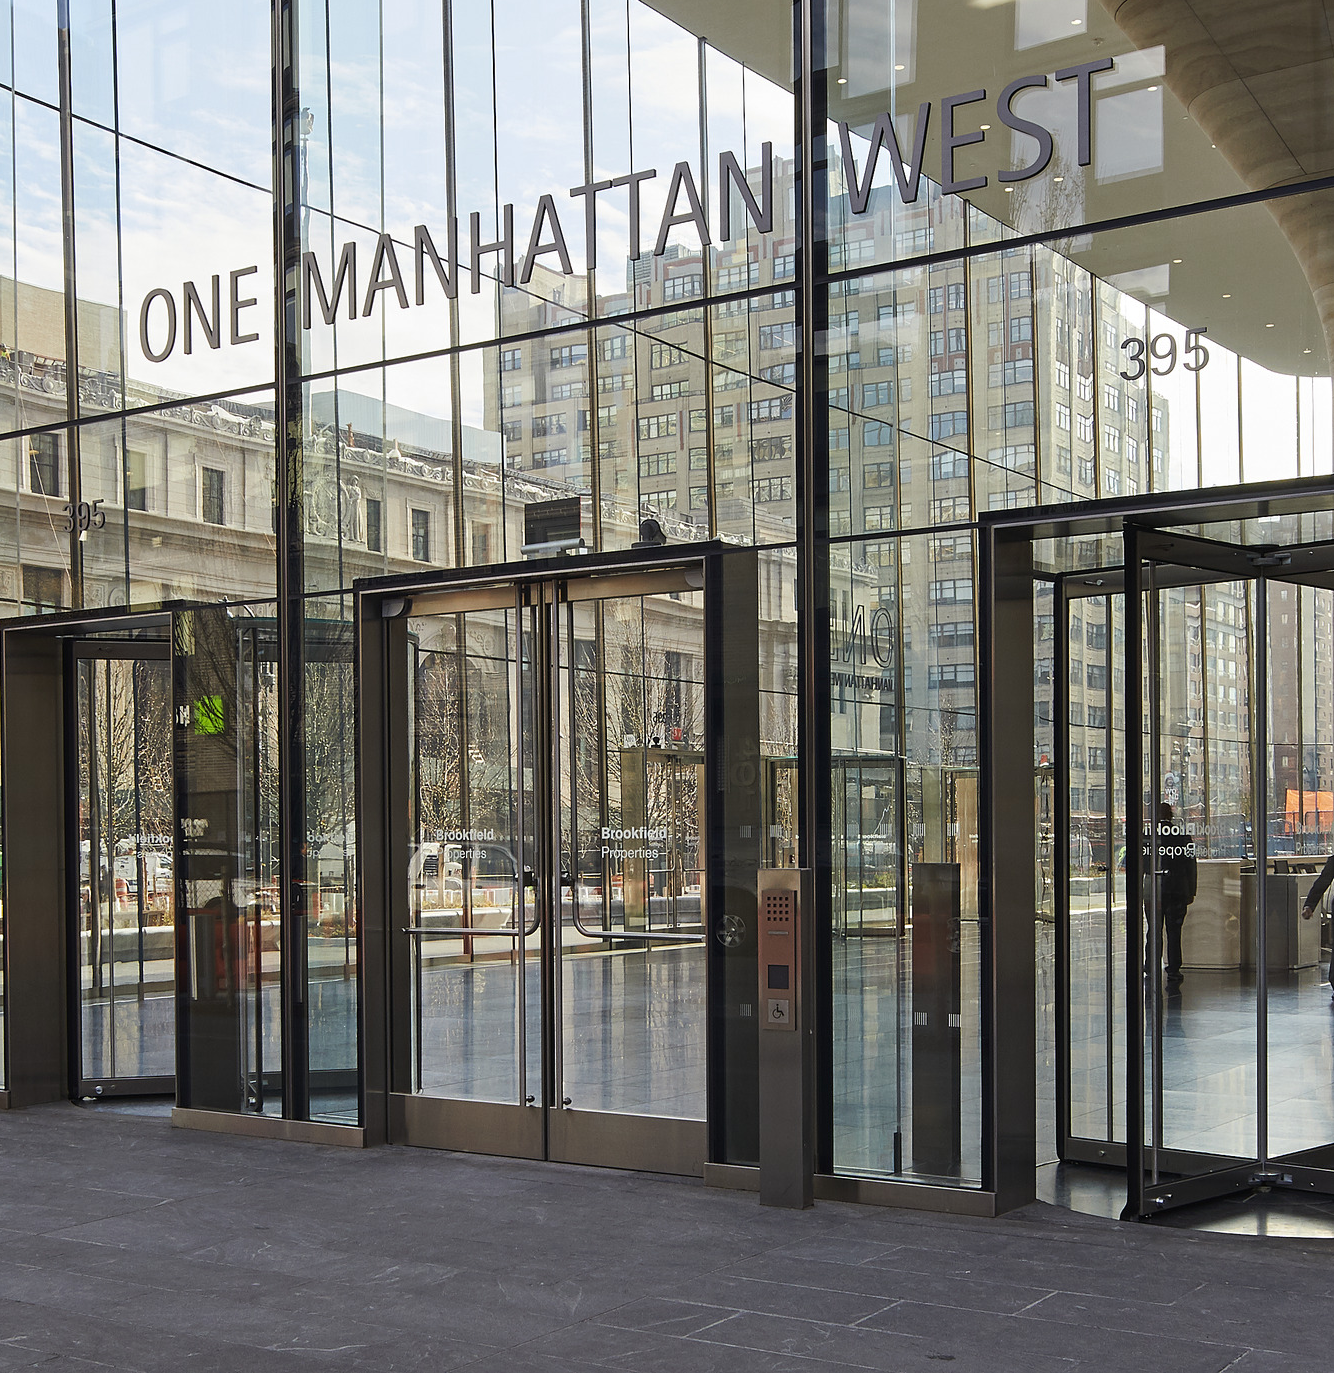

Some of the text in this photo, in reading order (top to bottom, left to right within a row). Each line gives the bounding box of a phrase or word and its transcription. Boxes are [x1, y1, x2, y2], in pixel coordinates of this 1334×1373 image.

[140, 57, 1114, 363] ONE MANHATTAN WEST
[1120, 327, 1210, 381] 395
[62, 498, 106, 534] 395
[436, 828, 494, 841] Brookfield
[601, 826, 668, 841] Brookfield
[437, 846, 487, 860] Properties
[601, 845, 659, 859] Properties
